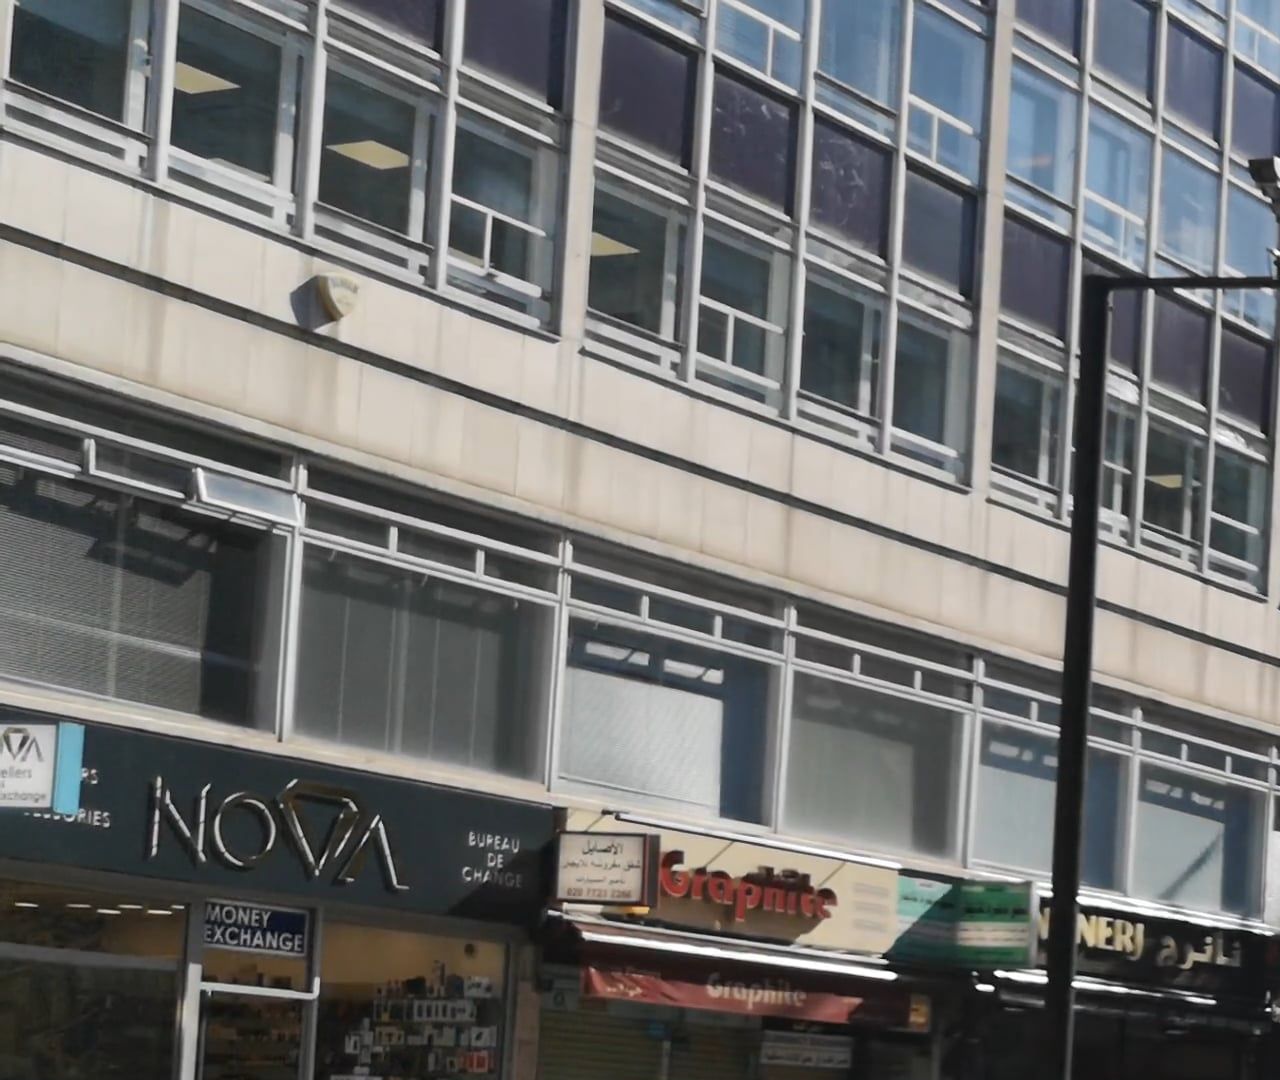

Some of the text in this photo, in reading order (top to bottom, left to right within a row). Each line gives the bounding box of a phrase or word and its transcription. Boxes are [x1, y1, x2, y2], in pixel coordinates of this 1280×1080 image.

[148, 776, 410, 890] NOVA
[468, 831, 520, 853] BUREAU
[488, 852, 503, 868] DE
[462, 867, 522, 888] CHANGE
[661, 850, 837, 922] Graphite
[205, 903, 271, 926] MONEY
[203, 923, 303, 951] EXCHANGE
[706, 972, 808, 1010] Graphite
